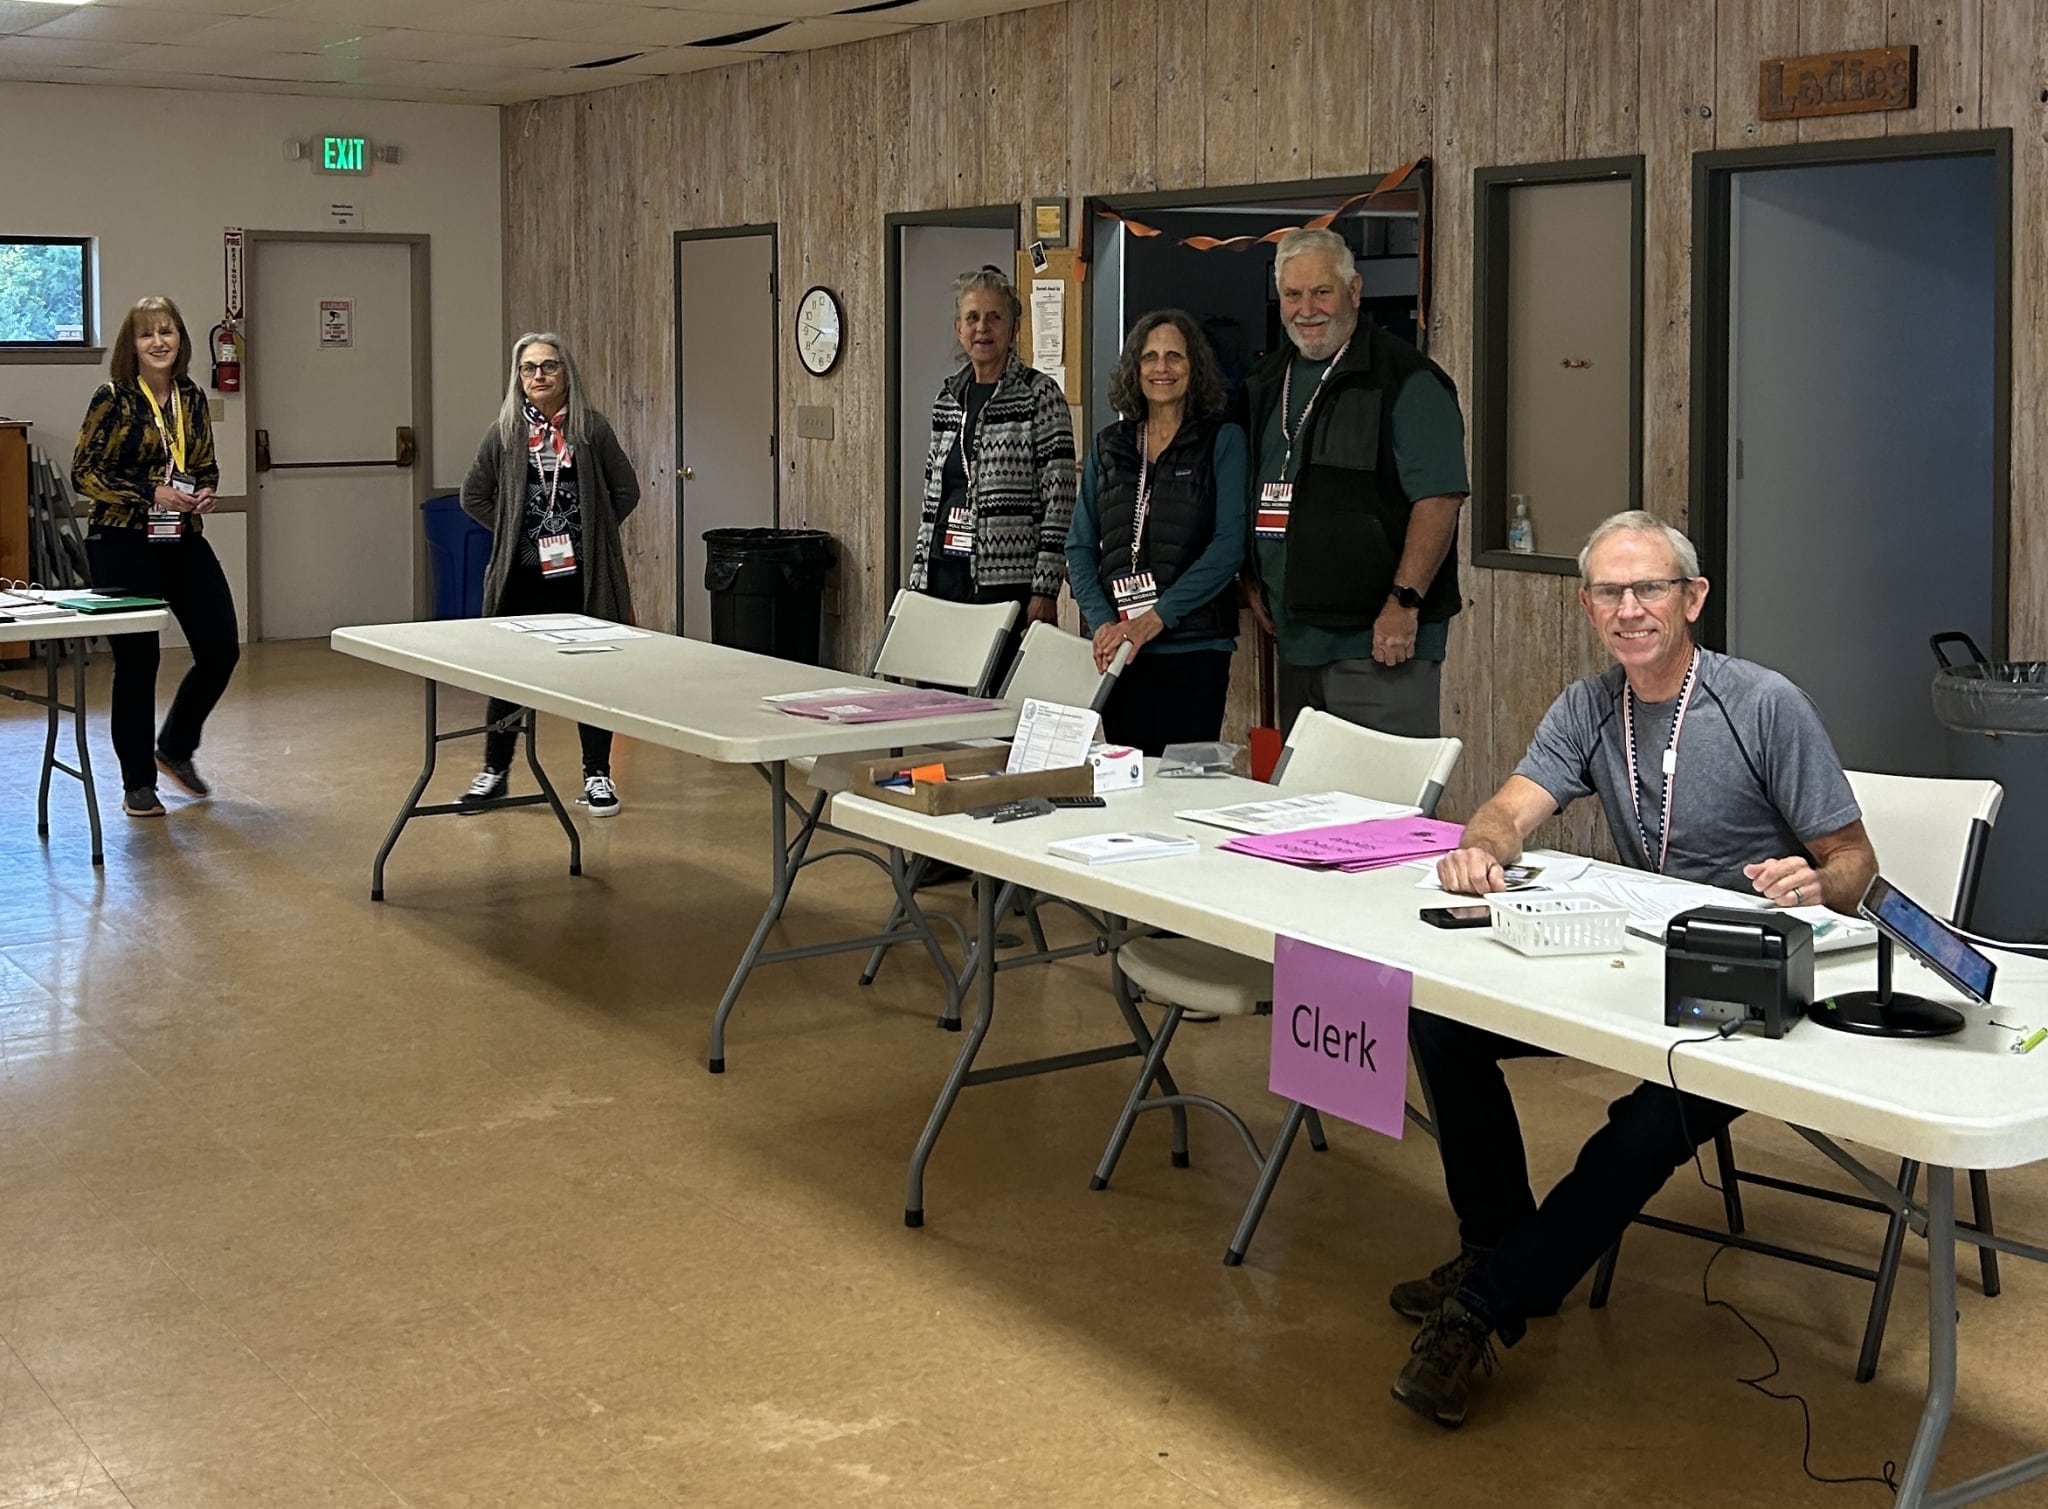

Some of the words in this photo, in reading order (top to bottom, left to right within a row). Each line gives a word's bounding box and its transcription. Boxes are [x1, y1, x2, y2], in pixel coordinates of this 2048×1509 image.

[1766, 58, 1909, 114] Ladies
[324, 138, 365, 170] EXIT
[226, 237, 241, 247] FIRE
[812, 301, 817, 309] 11
[819, 296, 825, 306] 12
[806, 312, 812, 321] 10
[806, 342, 811, 351] 8
[812, 353, 817, 362] 7
[819, 358, 824, 367] 6
[826, 353, 832, 363] 5
[1291, 1003, 1377, 1072] Clerk
